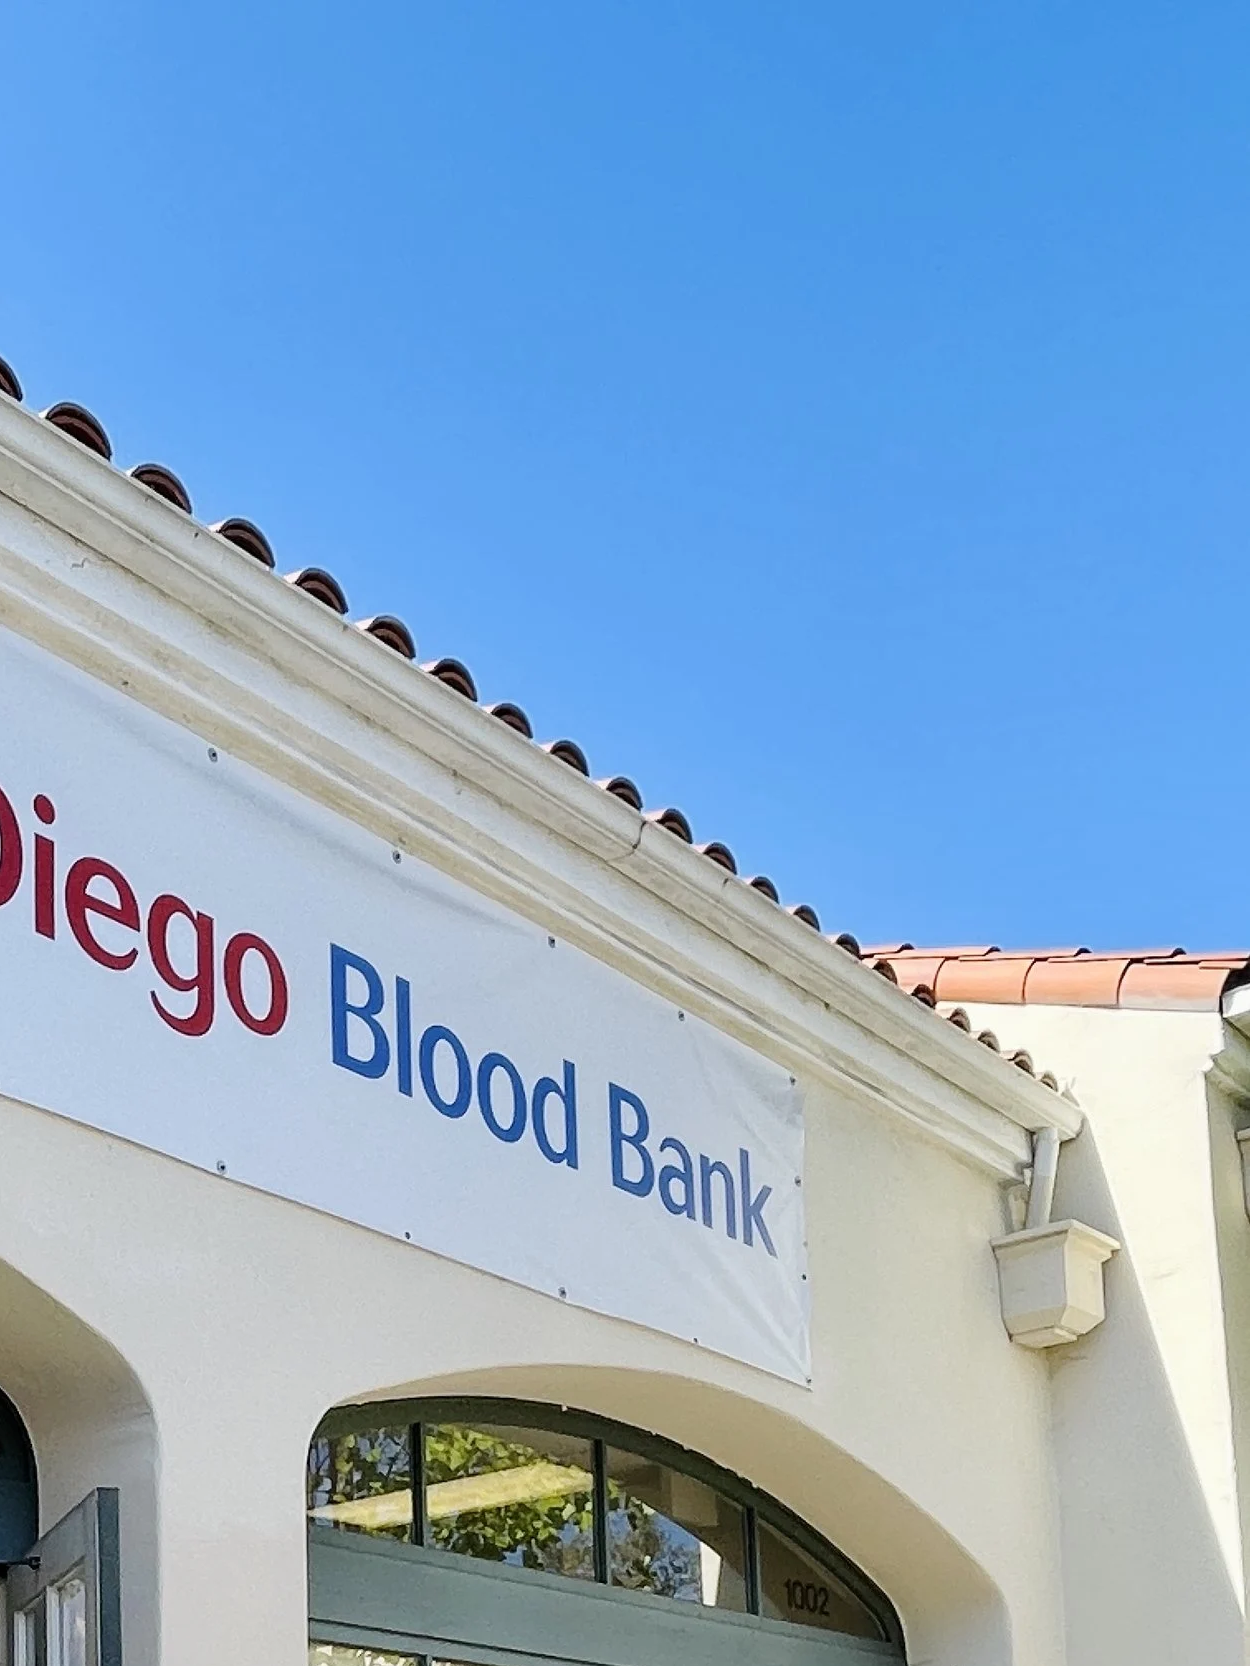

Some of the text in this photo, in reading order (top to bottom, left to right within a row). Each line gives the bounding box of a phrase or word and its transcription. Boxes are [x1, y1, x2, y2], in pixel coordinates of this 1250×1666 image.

[329, 942, 579, 1170] Blood
[608, 1081, 778, 1258] Bank
[783, 1578, 830, 1617] 1002
